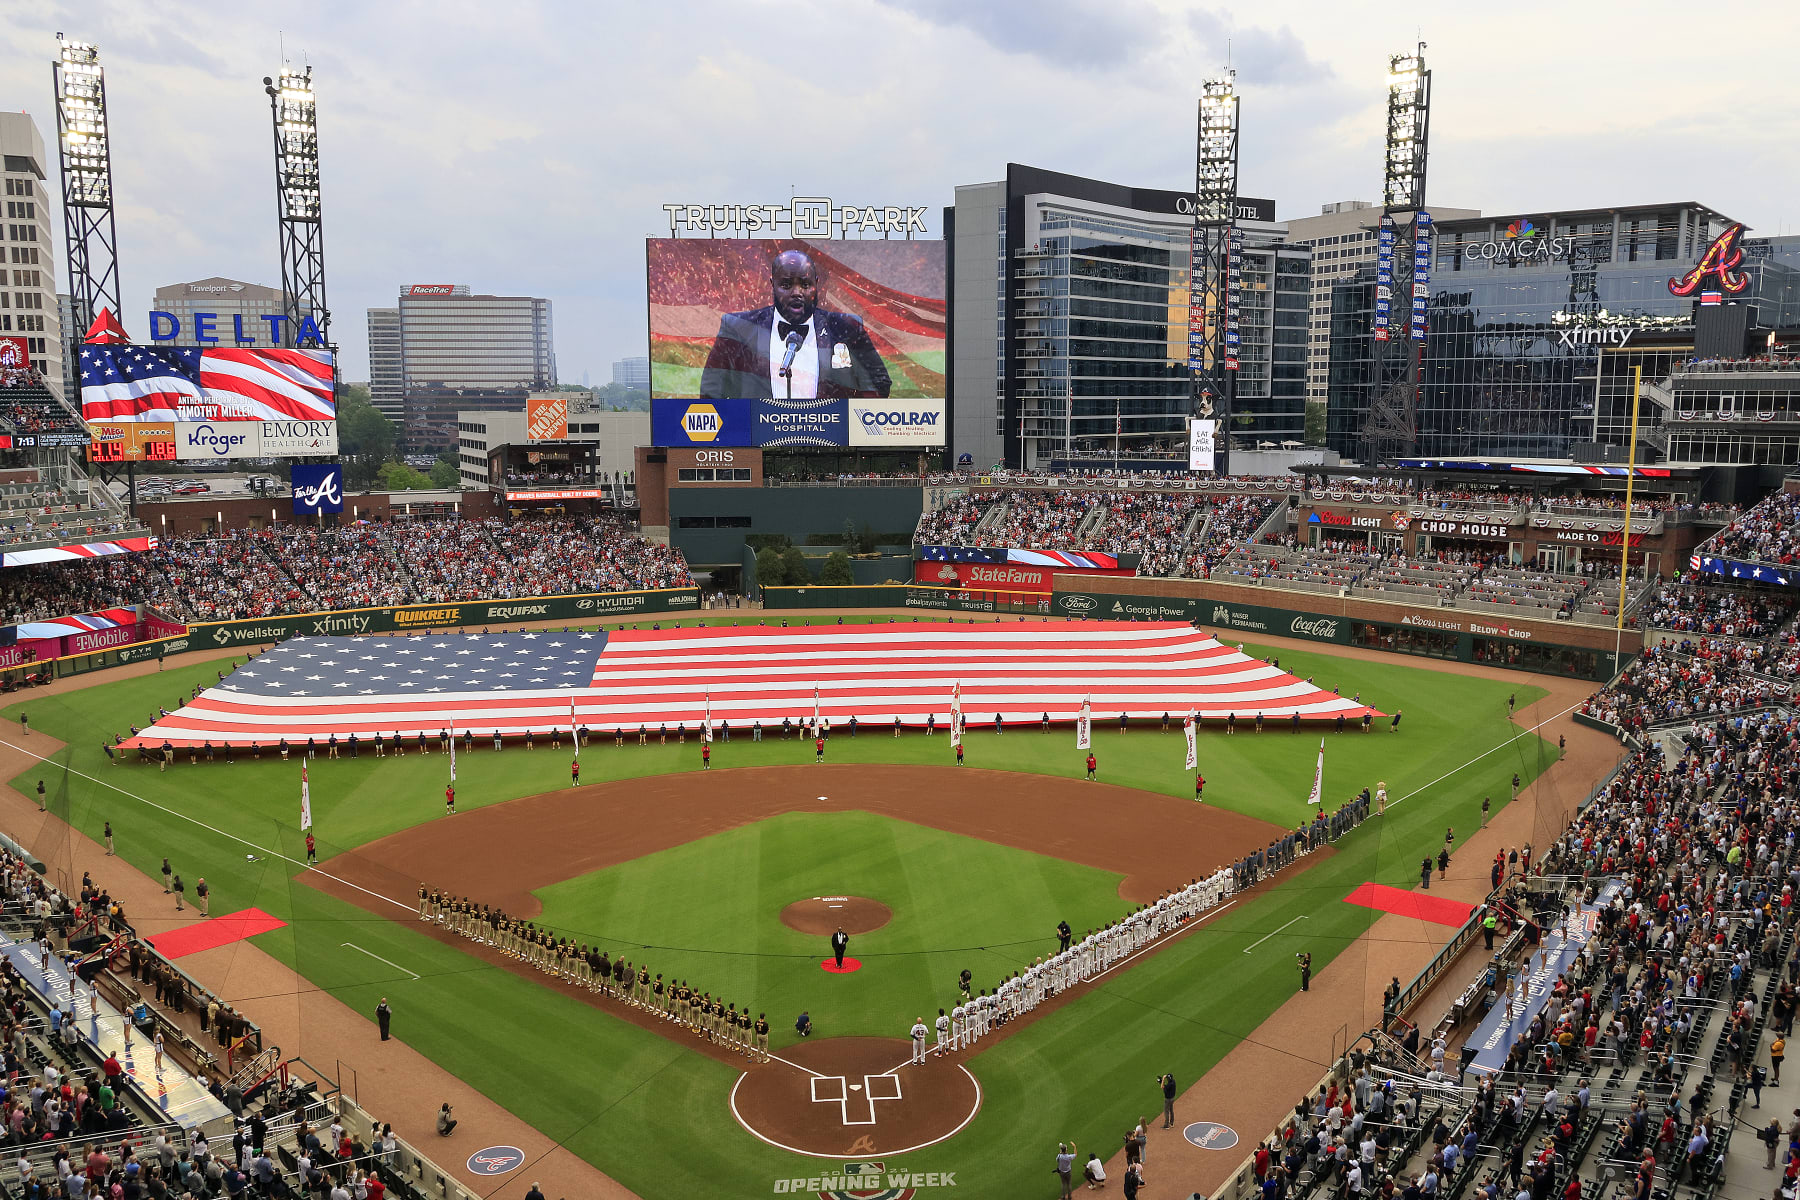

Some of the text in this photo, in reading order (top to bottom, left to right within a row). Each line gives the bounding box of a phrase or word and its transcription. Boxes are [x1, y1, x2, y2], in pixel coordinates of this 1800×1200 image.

[663, 205, 928, 232] TRUIST PARK
[1465, 238, 1574, 261] COMCAST
[189, 285, 227, 293] Travelport
[149, 311, 324, 344] DELTA
[1557, 328, 1634, 348] xfinity
[177, 406, 256, 418] TIMOTHY MILLER
[532, 404, 547, 419] THE
[760, 413, 840, 423] NORTHSIDE
[862, 411, 940, 425] COOLRAY
[528, 400, 566, 439] HOME
[544, 414, 567, 439] DEPOT
[688, 414, 717, 431] NAPA
[263, 422, 333, 437] EMORY
[17, 437, 35, 447] 7:13
[188, 425, 246, 455] Kroger
[264, 439, 330, 447] HEALTHCARE
[150, 442, 176, 455] 186
[696, 451, 734, 462] ORIS
[1321, 511, 1381, 527] Coors LIGHT
[1421, 521, 1506, 536] CHOP HOUSE
[1557, 532, 1584, 540] MADE
[597, 597, 644, 607] HYUNDAI
[1066, 598, 1092, 609] Ford
[394, 608, 460, 622] QUIKRETE
[487, 605, 548, 618] EQUIFAX
[1126, 605, 1185, 616] Georgia Power
[313, 614, 370, 634] xfinity
[1232, 619, 1266, 630] PERMANENTE
[1412, 615, 1461, 630] Coors LIGHT
[234, 626, 286, 639] Wellstar
[1470, 624, 1498, 634] BELOW
[1509, 629, 1531, 638] CHOP
[774, 1172, 957, 1193] OPENING WEEK
